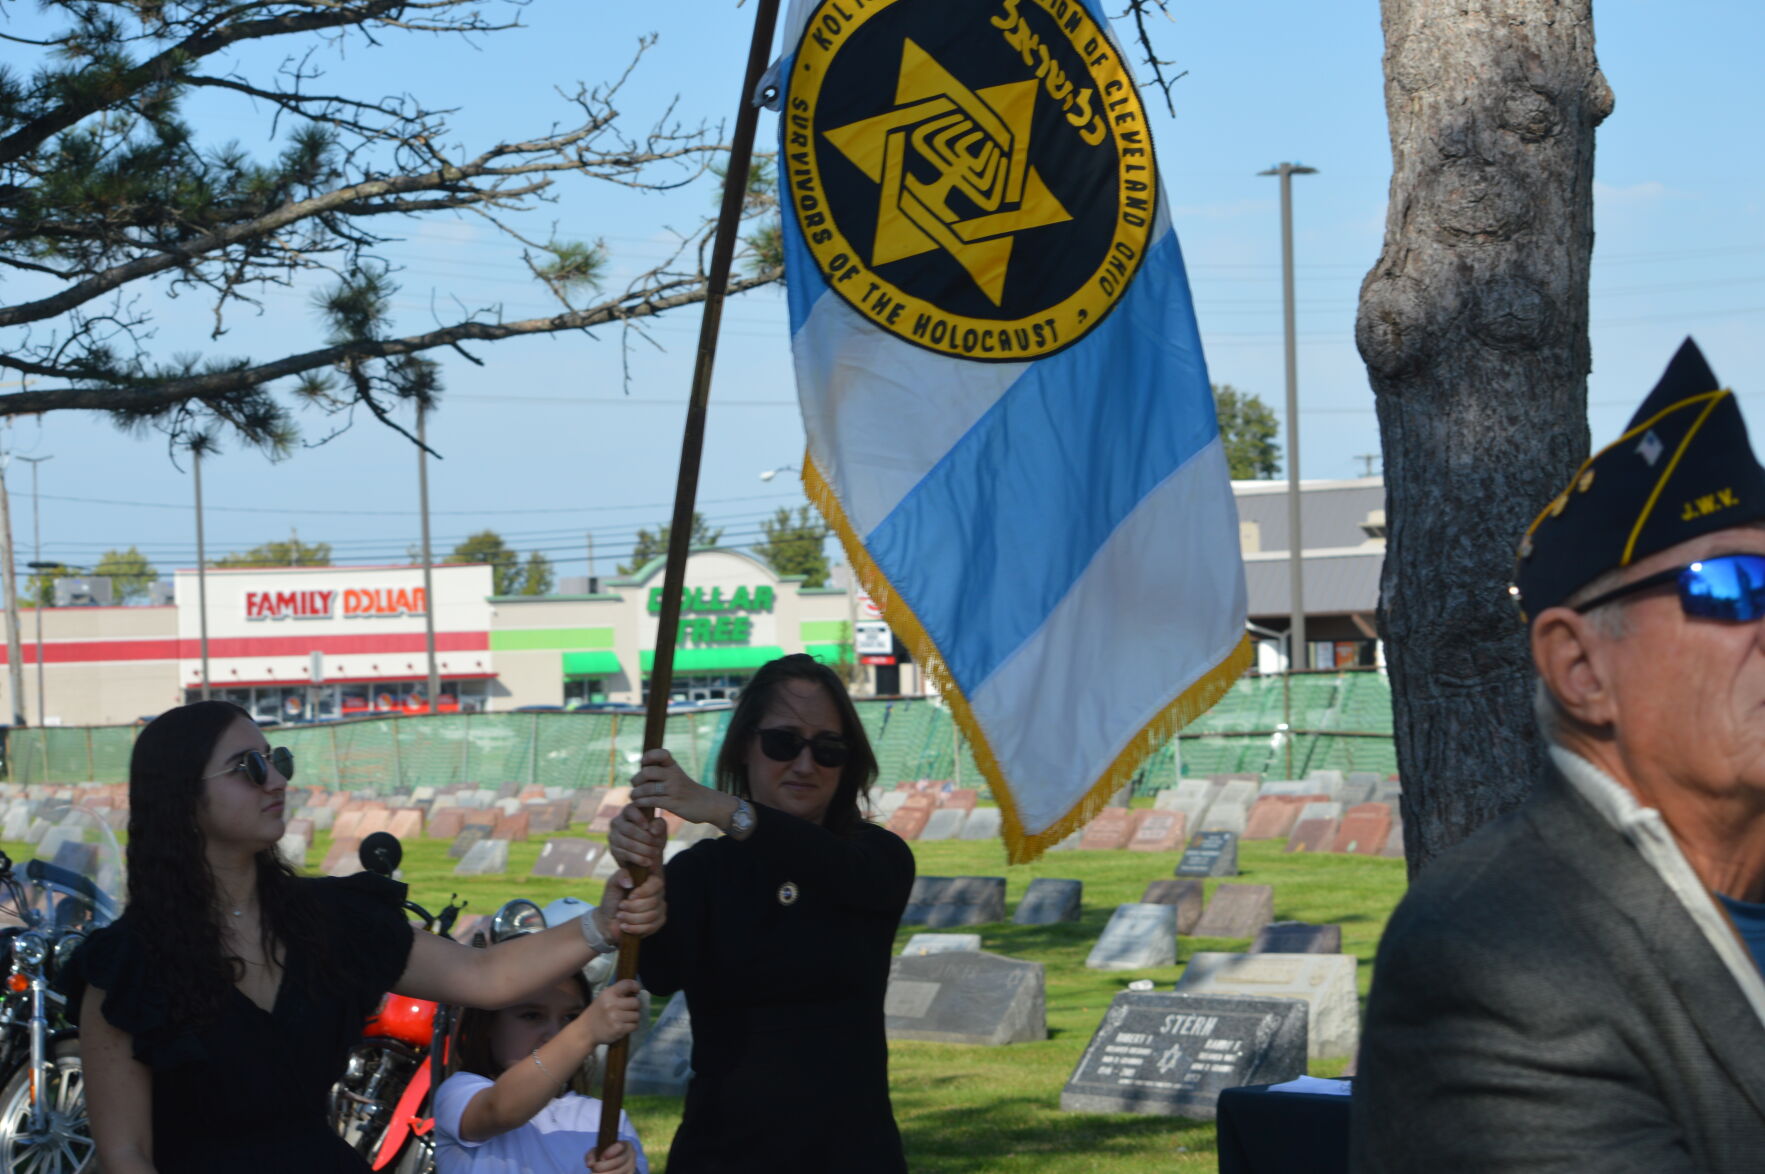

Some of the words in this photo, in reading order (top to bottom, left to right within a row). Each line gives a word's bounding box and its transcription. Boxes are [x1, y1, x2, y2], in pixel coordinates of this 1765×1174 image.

[812, 2, 854, 52] KOL
[1083, 36, 1109, 67] OF
[1104, 79, 1149, 228] CLEVELAND
[789, 96, 834, 246] SURVIVORS
[828, 252, 861, 284] OF
[860, 281, 906, 326] THE
[912, 312, 1060, 353] HOLOCAUST
[1098, 241, 1136, 298] OHIO
[245, 590, 334, 617] FAMILY
[343, 587, 427, 615] DOLLAR
[1159, 1014, 1219, 1037] STERN
